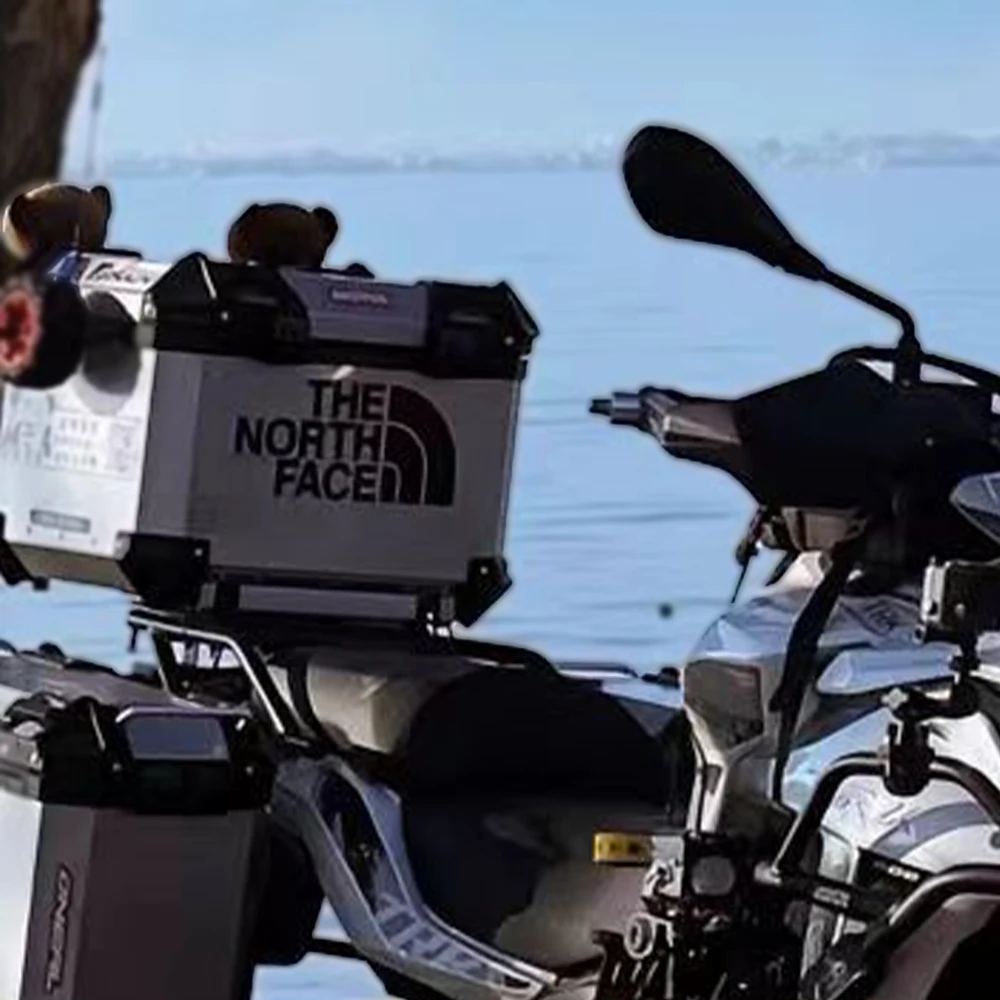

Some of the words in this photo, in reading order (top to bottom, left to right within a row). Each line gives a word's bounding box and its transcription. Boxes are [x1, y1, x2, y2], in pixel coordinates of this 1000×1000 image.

[308, 379, 386, 421] THE
[234, 416, 382, 461] NORTH
[273, 458, 378, 504] FACE
